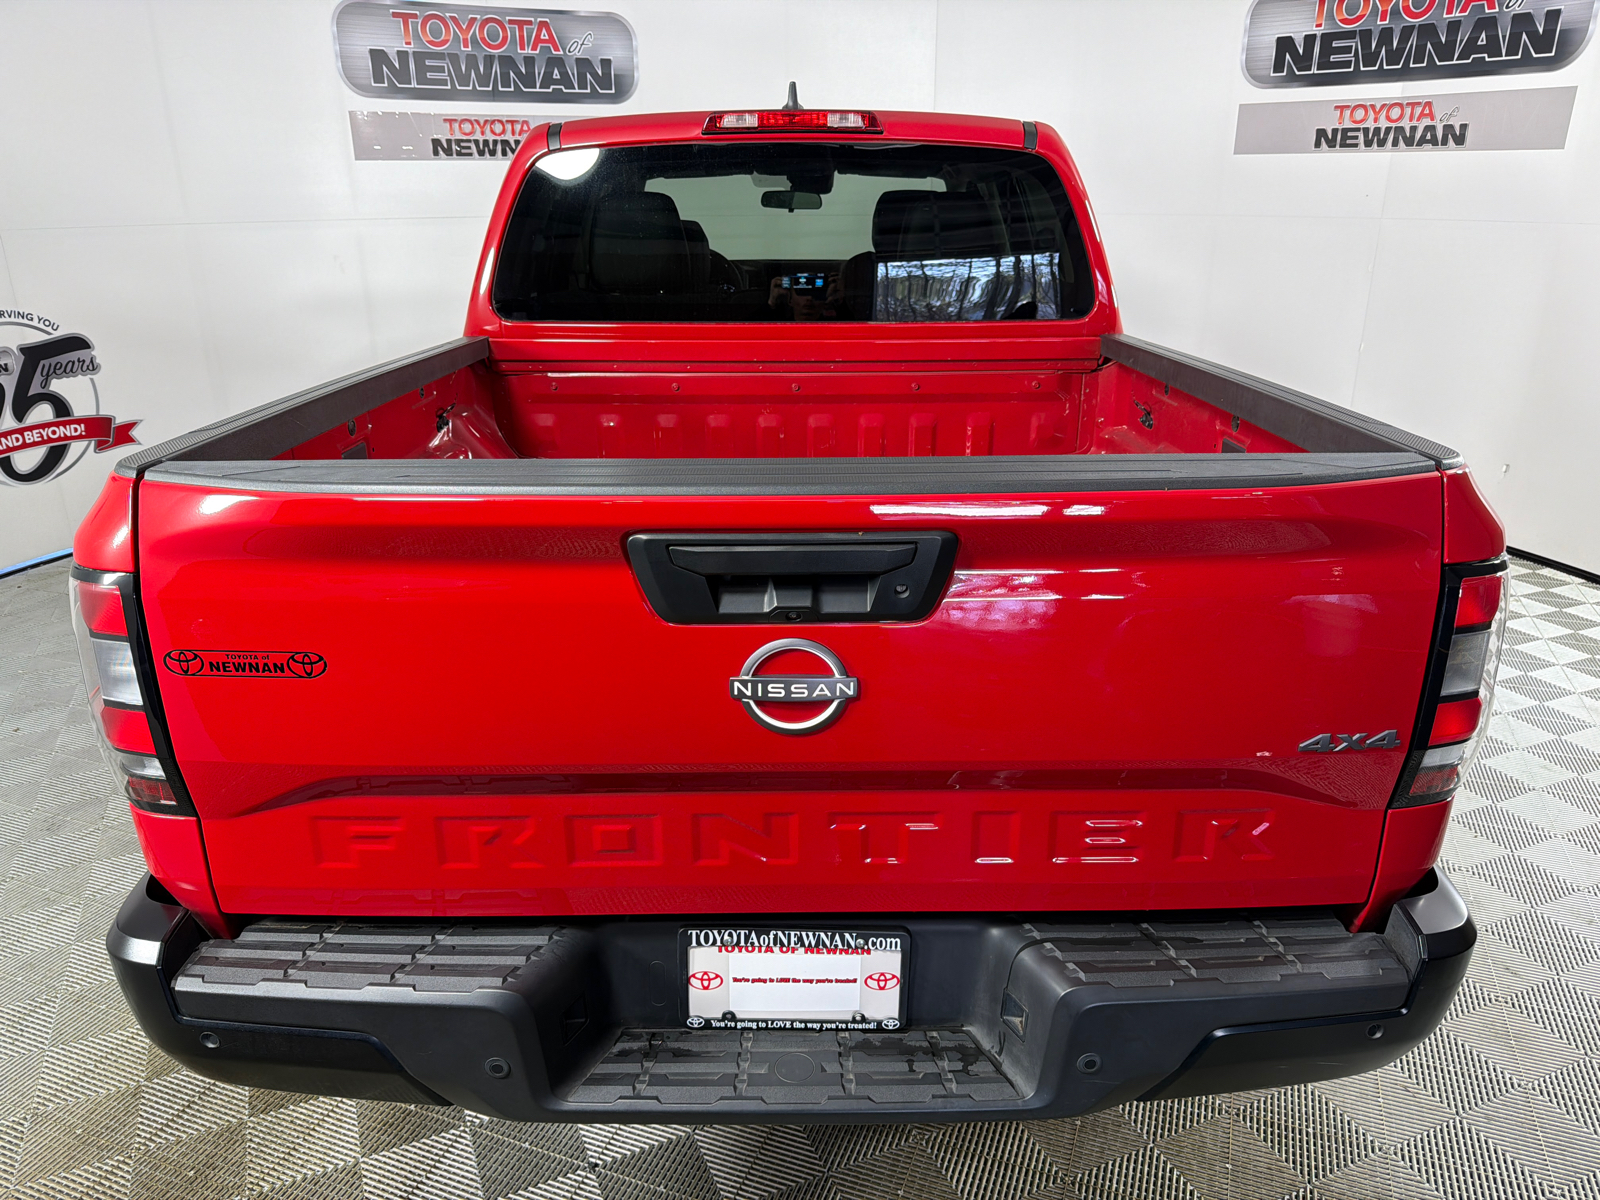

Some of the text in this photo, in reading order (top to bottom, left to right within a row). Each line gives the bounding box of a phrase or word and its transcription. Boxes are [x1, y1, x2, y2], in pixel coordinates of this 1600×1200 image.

[391, 11, 593, 55] TOYOTA of
[1270, 7, 1564, 76] NEWNAN
[368, 48, 615, 93] NEWNAN
[1334, 100, 1459, 125] TOYOTA of
[442, 117, 532, 137] TOYOTA
[1313, 122, 1468, 150] NEWNAN
[430, 138, 523, 157] NEWN
[0, 309, 60, 332] RVING YOU
[40, 356, 99, 390] years
[23, 423, 86, 444] BEYOND!
[208, 661, 286, 674] NEWNAN
[733, 681, 854, 698] NISSAN
[306, 808, 1276, 869] FRONTIER
[710, 1020, 735, 1028] You're
[736, 1021, 757, 1029] going
[793, 1021, 805, 1029] the
[822, 1022, 847, 1030] you're
[848, 1021, 877, 1029] treated!
